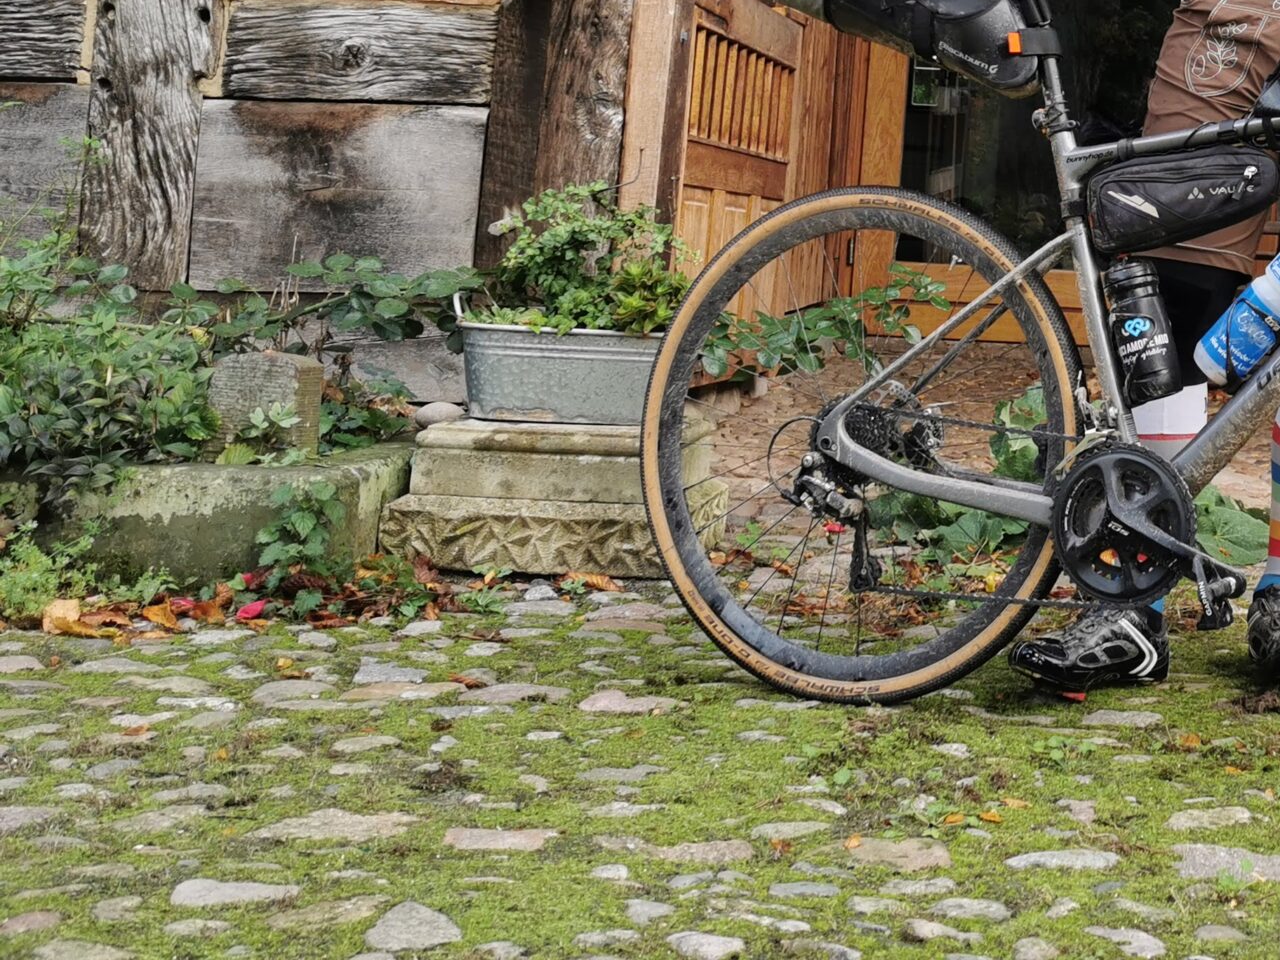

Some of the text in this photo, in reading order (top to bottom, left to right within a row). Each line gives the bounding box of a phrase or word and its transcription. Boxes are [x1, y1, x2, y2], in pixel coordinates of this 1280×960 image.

[858, 197, 961, 232] SCHWALBE
[1198, 581, 1212, 617] GARMIN
[703, 614, 880, 695] SCHWALBE G-ONE
